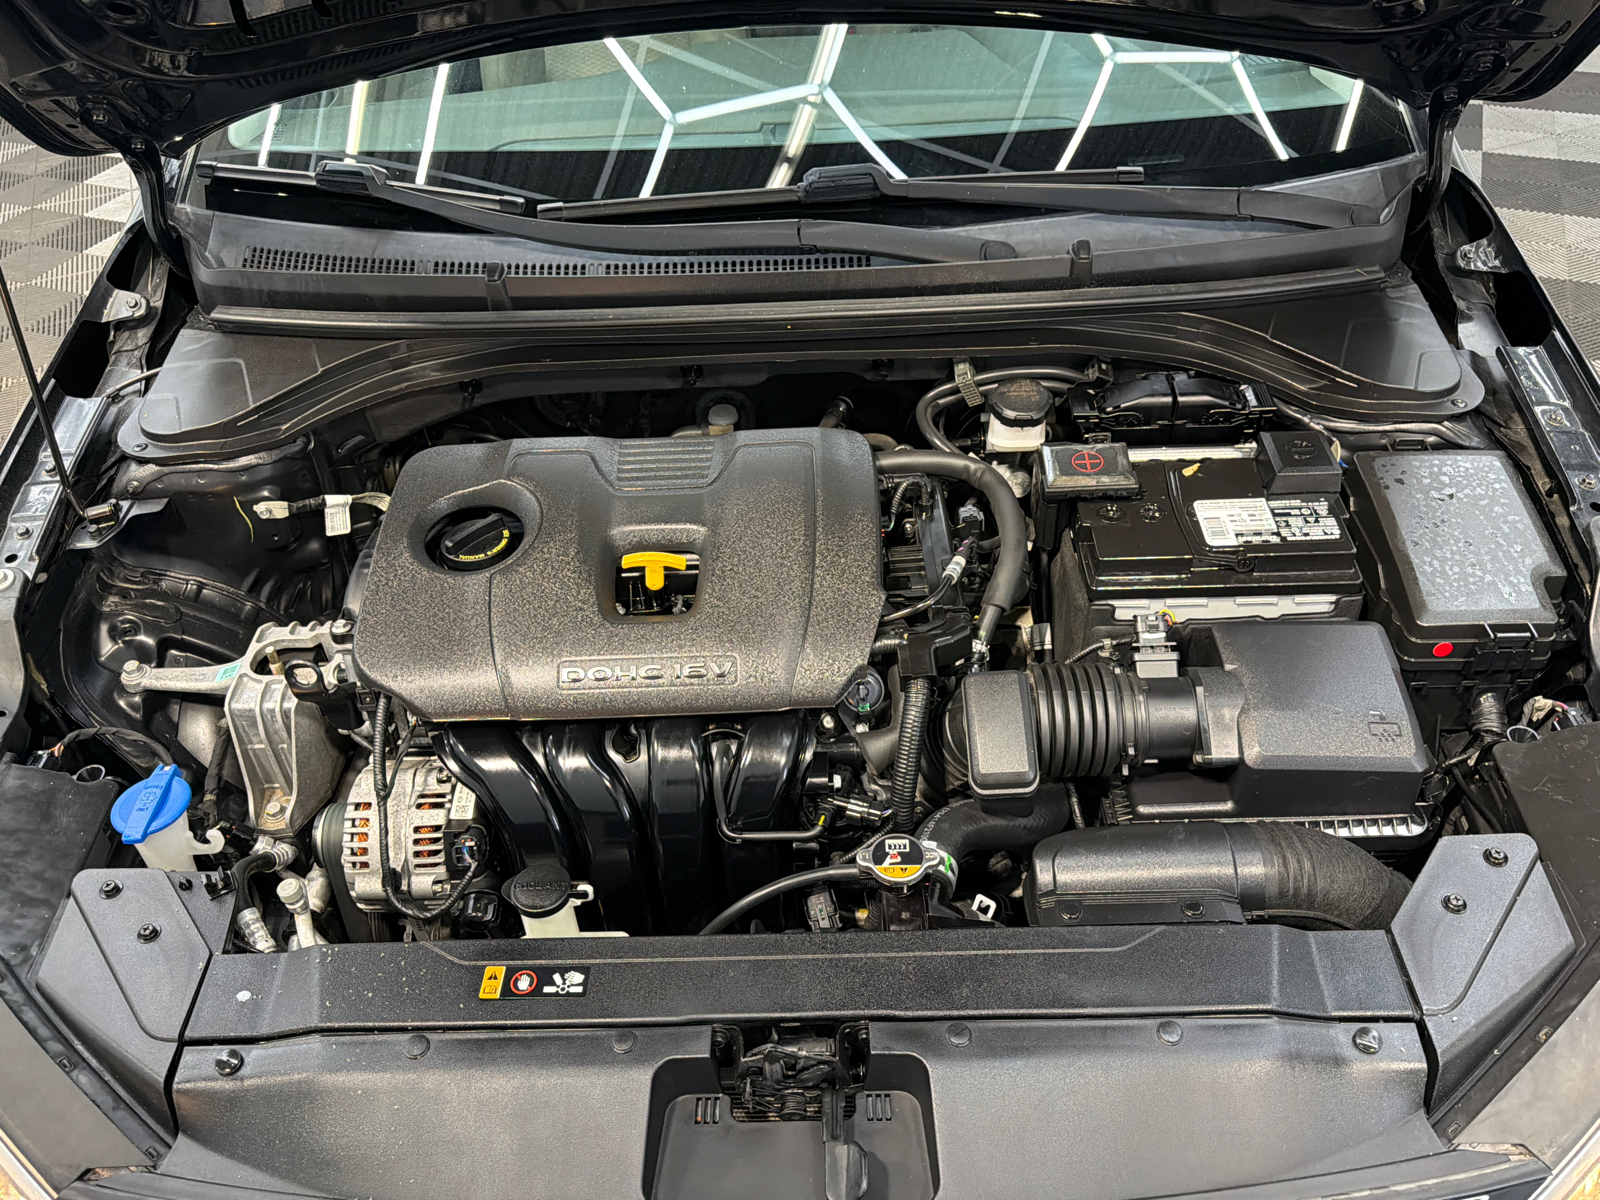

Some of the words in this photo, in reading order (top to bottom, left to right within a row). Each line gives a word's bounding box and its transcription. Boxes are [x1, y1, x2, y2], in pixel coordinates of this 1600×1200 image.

[486, 538, 509, 556] OWNER'S
[458, 553, 486, 561] MANUAL
[561, 664, 664, 683] DOHC
[674, 661, 735, 680] 16V
[513, 880, 570, 891] COOLANT
